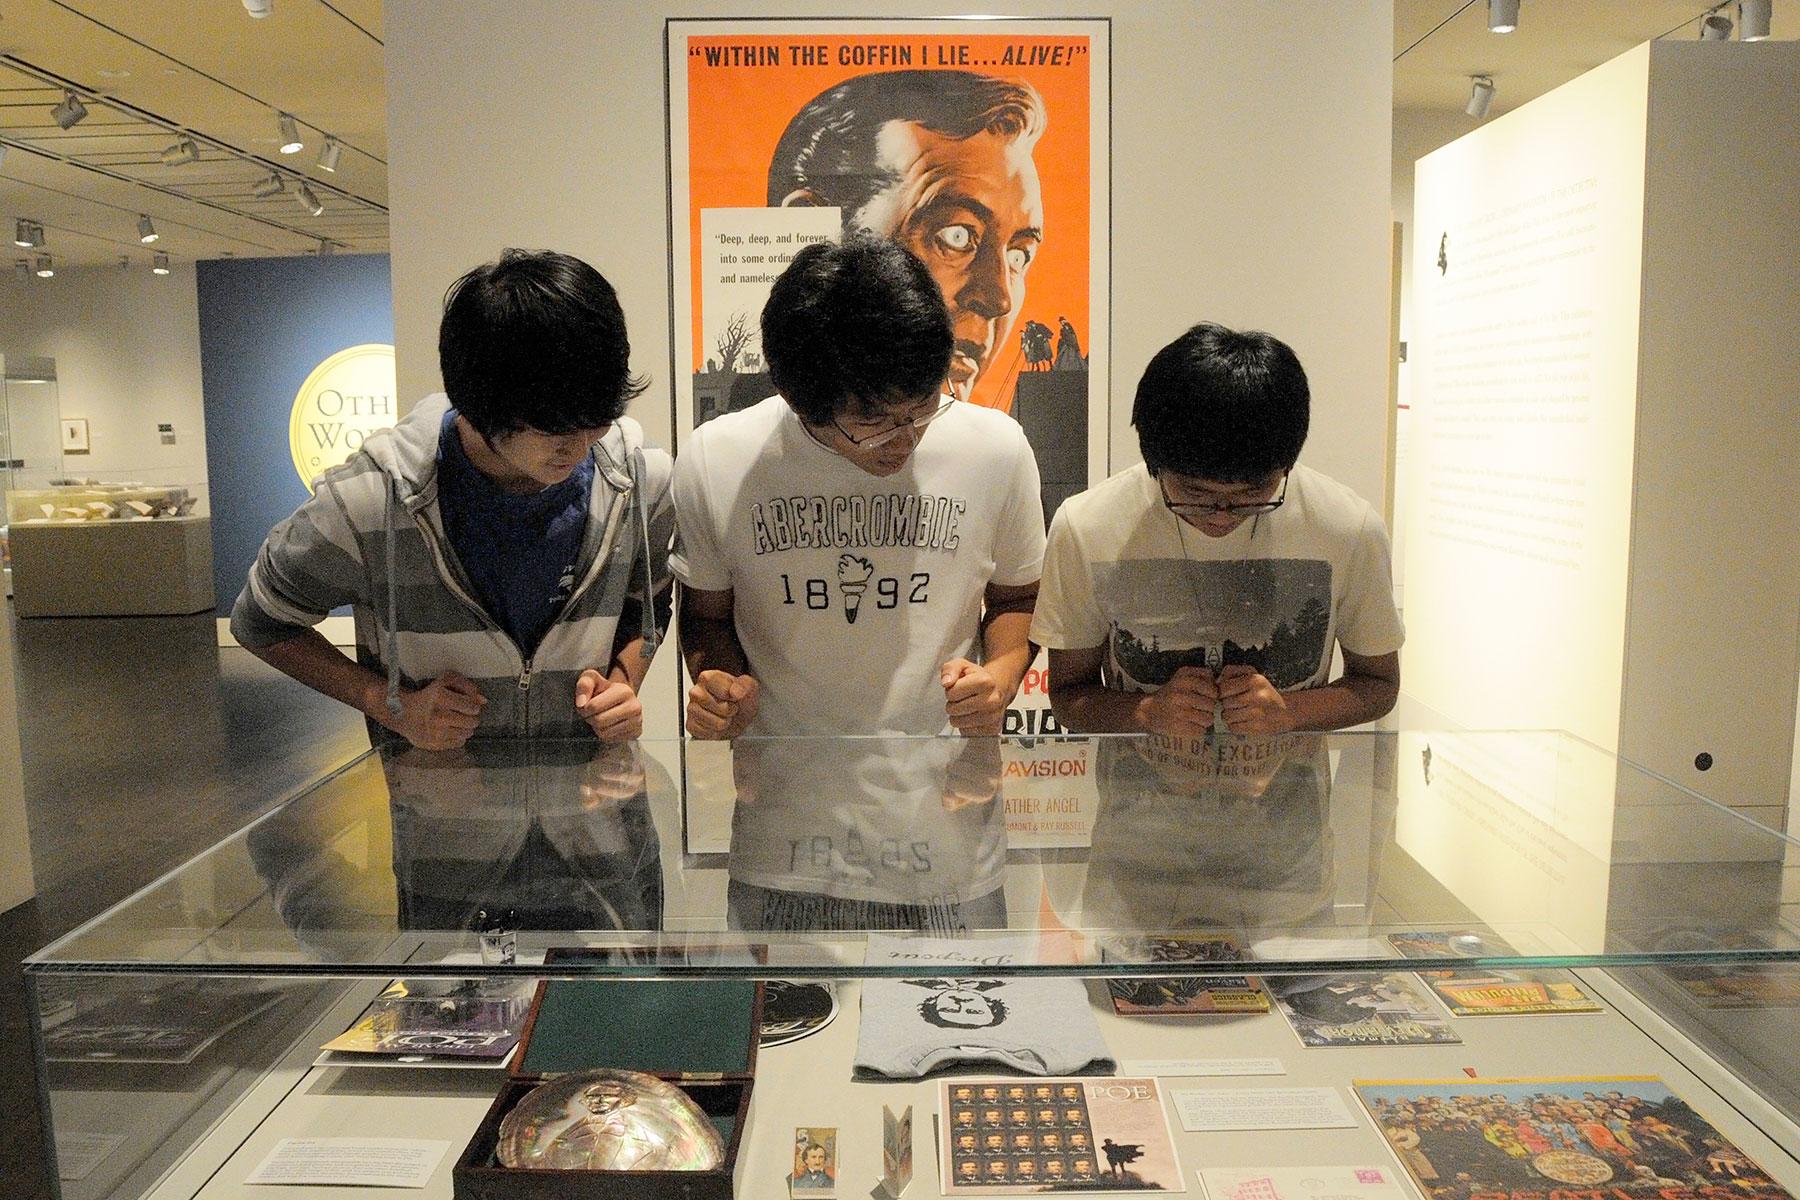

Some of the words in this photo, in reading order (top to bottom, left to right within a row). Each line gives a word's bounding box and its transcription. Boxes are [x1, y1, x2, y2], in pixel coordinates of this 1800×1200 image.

[789, 46, 829, 66] THE
[838, 45, 912, 66] COFFIN
[922, 45, 927, 66] I
[748, 233, 772, 246] deep,
[776, 233, 792, 243] and
[796, 232, 827, 243] forever
[720, 253, 738, 264] into
[741, 254, 765, 264] some
[720, 273, 736, 284] and
[751, 495, 966, 555] ABERCROMBIE
[1004, 798, 1040, 814] ATHER
[1046, 798, 1081, 814] ANGEL
[1090, 1086, 1152, 1100] POE
